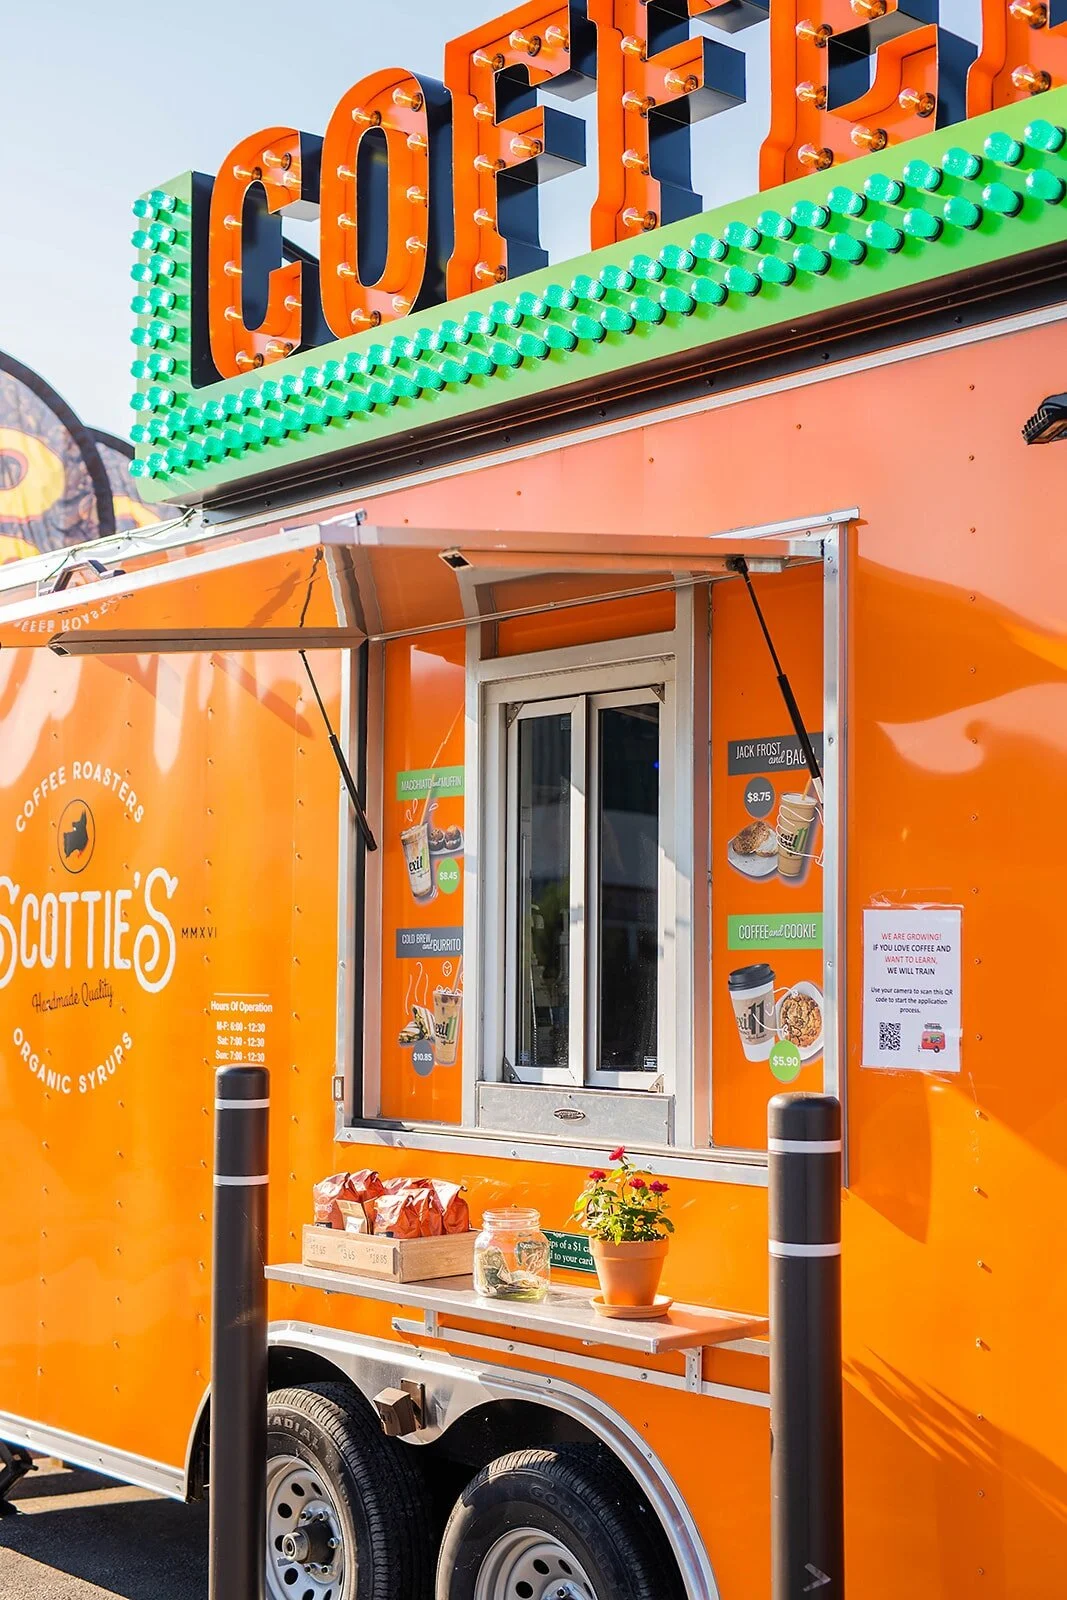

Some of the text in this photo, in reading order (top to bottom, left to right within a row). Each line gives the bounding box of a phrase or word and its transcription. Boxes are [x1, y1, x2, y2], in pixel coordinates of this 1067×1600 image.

[208, 0, 1067, 381] COFFE
[736, 741, 781, 759] JACK FROST
[768, 747, 816, 766] and BAG
[16, 761, 144, 832] COFFEE ROASTERS
[747, 791, 771, 803] $8.75
[439, 871, 458, 881] $8.45
[181, 927, 217, 939] MMXVI
[738, 923, 816, 940] COFFEE and COOKIE
[906, 933, 942, 941] GROWING!
[401, 933, 431, 944] COLD BREW
[433, 938, 461, 951] BURRITO
[894, 944, 910, 952] LOVE
[911, 944, 935, 952] COFFEE
[887, 967, 936, 975] WE WILL TRAIN
[32, 978, 114, 1014] Handmade Quality
[211, 1000, 273, 1013] Hours Of Operation
[248, 1023, 265, 1032] 12:30
[217, 1035, 228, 1045] Sat:
[230, 1036, 242, 1046] 7:00
[248, 1038, 265, 1047] 12:30
[13, 1027, 132, 1094] ORGANIC SYRUPS
[215, 1050, 228, 1059] Sun:
[230, 1051, 242, 1061] 7:00
[248, 1052, 265, 1062] 12:30
[413, 1052, 432, 1062] $10.85
[772, 1056, 799, 1067] $5.90
[560, 1240, 567, 1249] of
[573, 1241, 581, 1251] $1
[562, 1255, 577, 1263] your
[578, 1257, 593, 1265] card
